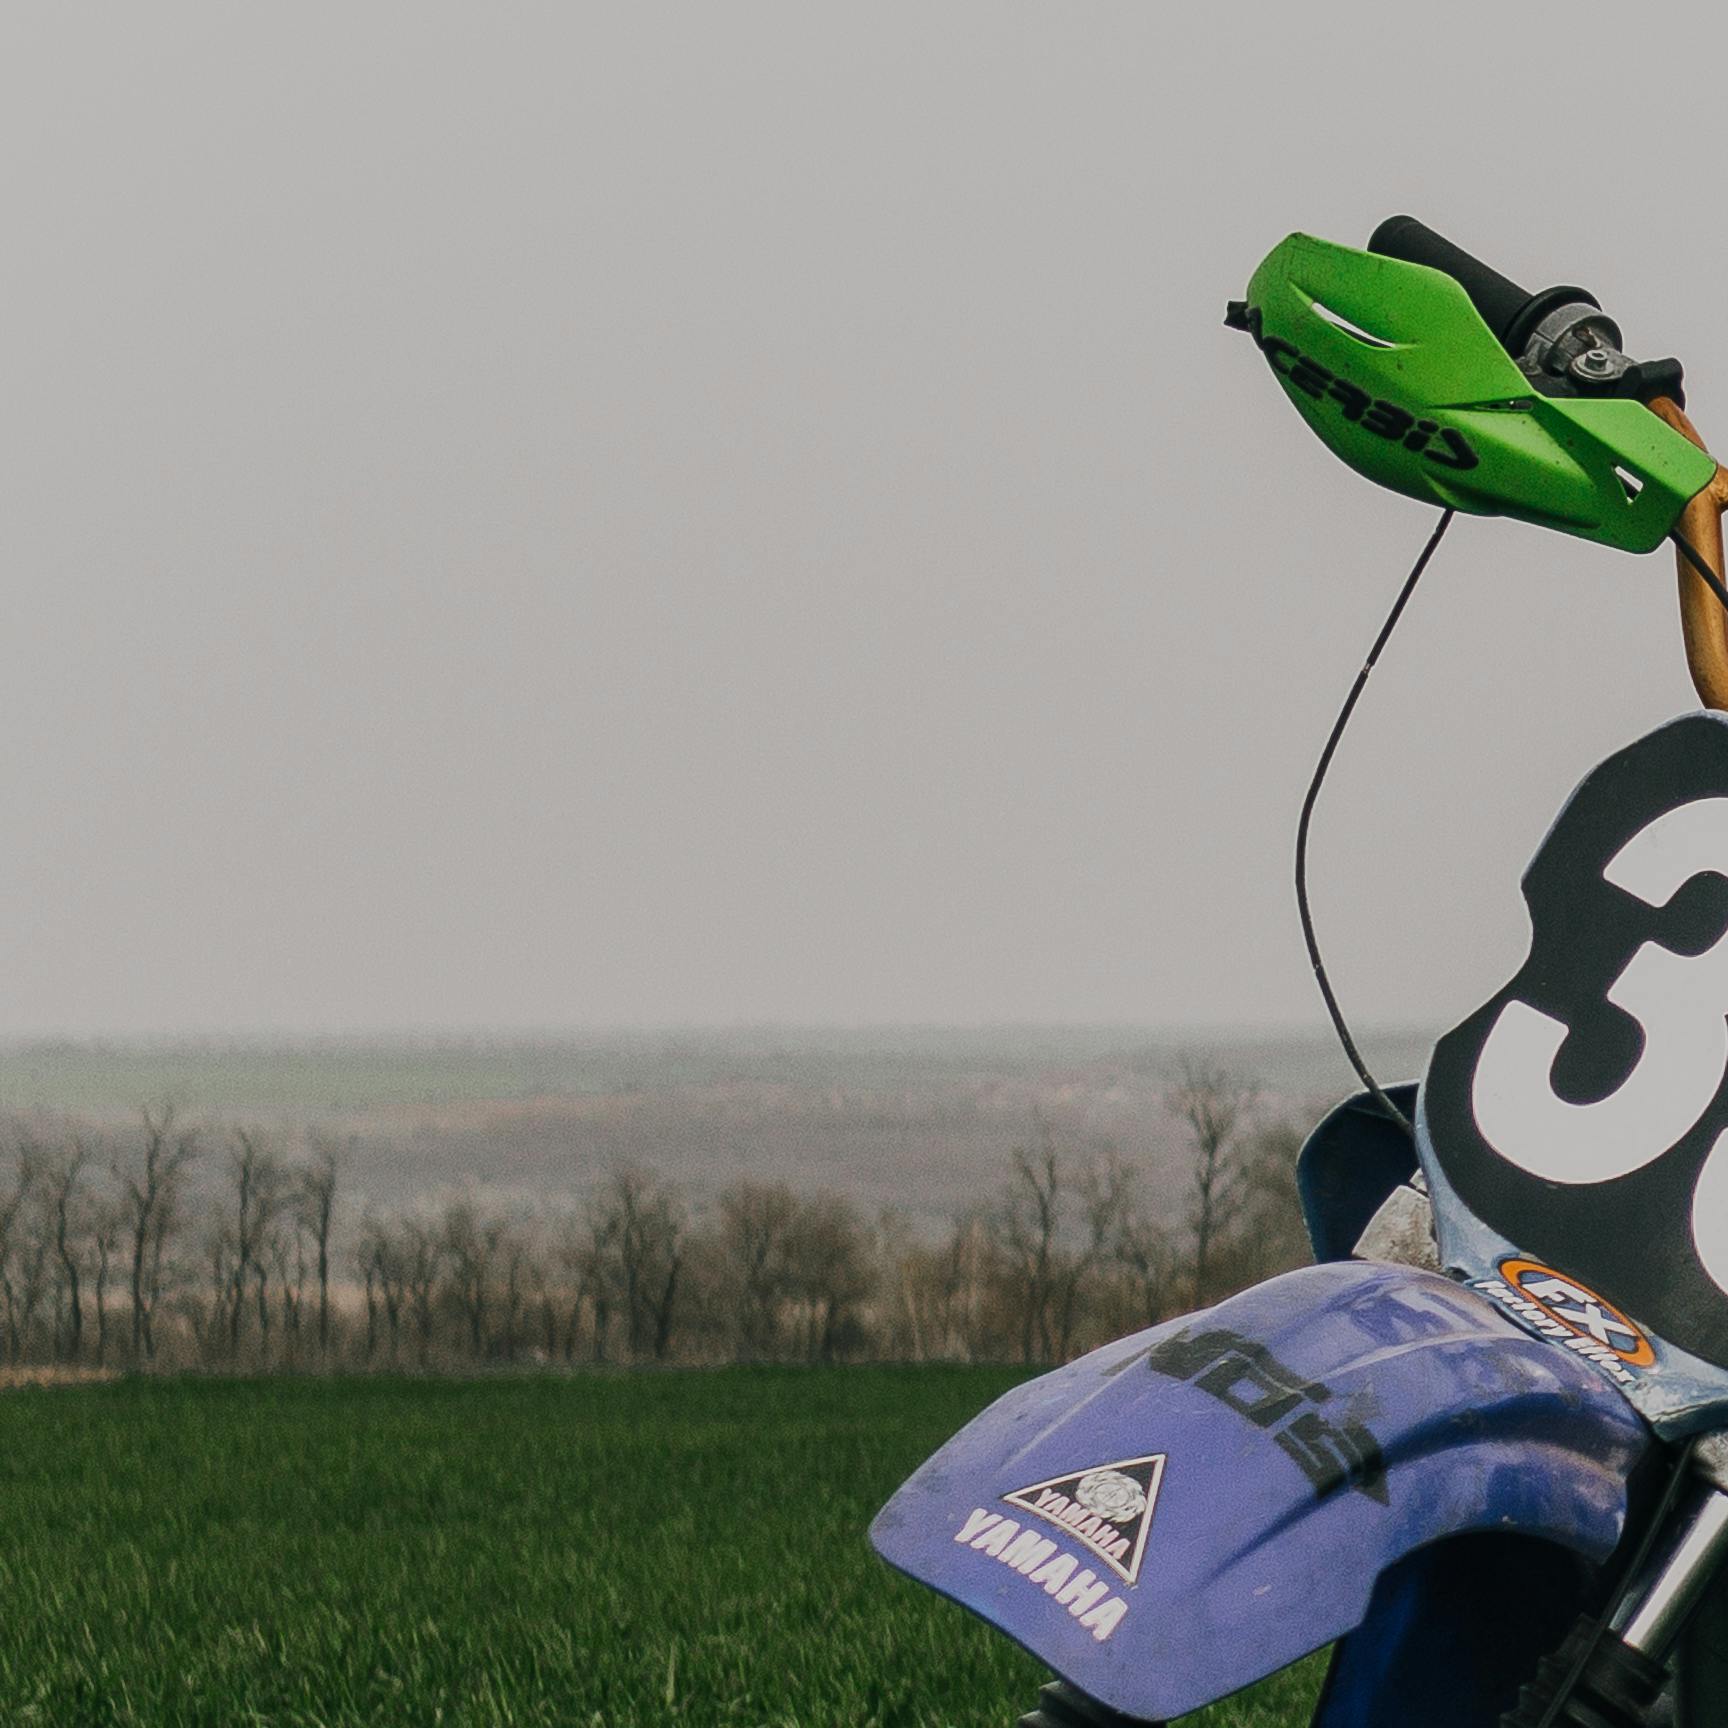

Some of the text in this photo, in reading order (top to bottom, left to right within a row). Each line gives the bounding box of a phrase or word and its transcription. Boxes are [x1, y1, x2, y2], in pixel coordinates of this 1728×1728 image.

[1520, 1277, 1638, 1345] FX
[1033, 1487, 1132, 1560] YAMAHA
[954, 1507, 1129, 1641] YAMAHA
